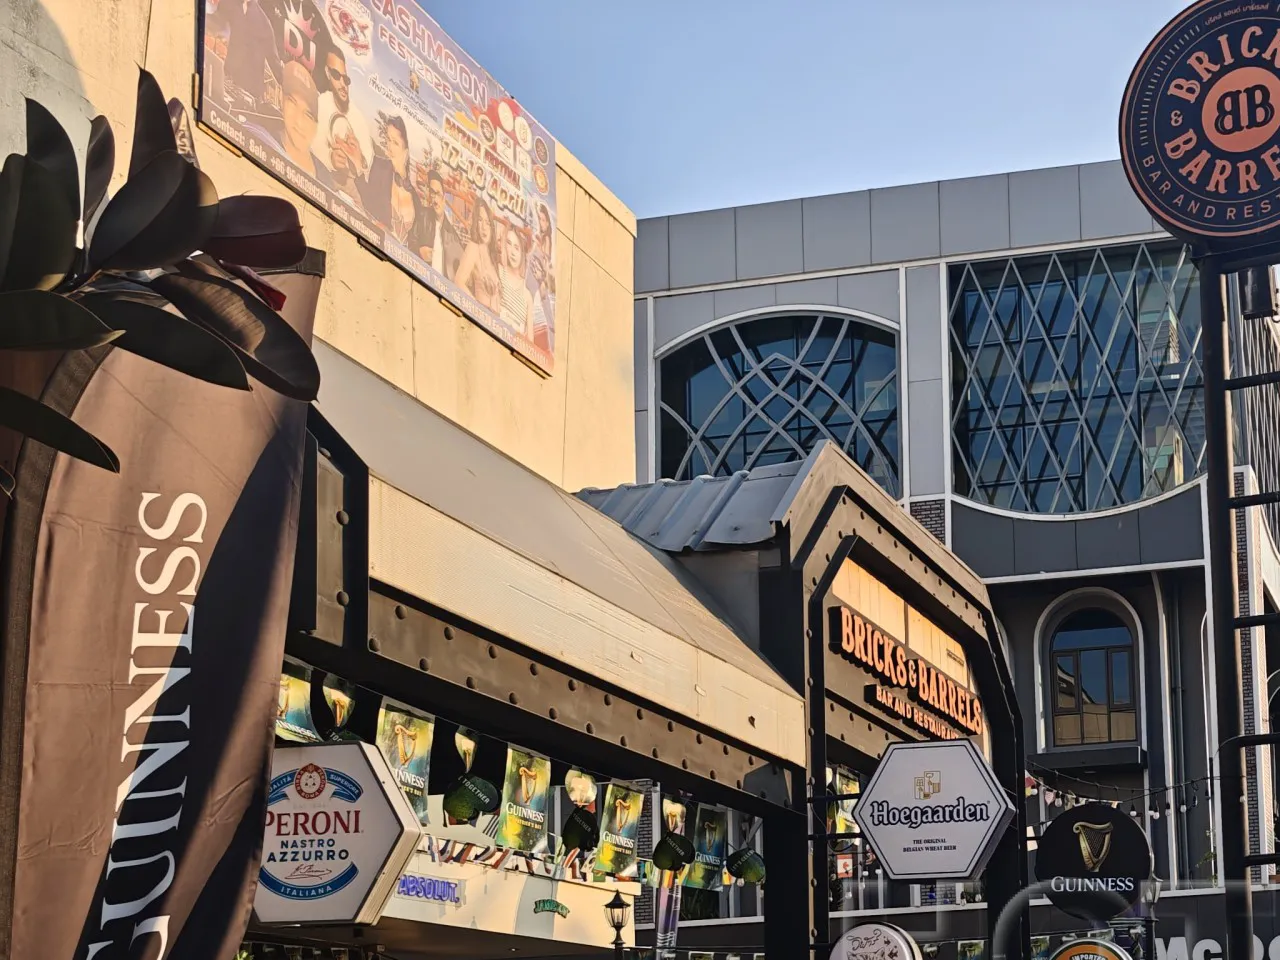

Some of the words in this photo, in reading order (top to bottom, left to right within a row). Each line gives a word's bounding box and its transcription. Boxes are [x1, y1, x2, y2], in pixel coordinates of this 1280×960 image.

[284, 18, 316, 72] DJ
[1142, 155, 1172, 195] BAR
[1173, 193, 1216, 219] AND
[840, 606, 908, 688] BRICKS
[909, 659, 917, 688] &
[917, 658, 982, 736] BARRELS
[876, 686, 894, 709] BAR
[894, 697, 912, 719] AND
[330, 774, 360, 795] SUPERIORE
[461, 777, 491, 805] TOGETHER
[506, 801, 545, 823] GUINNESS
[870, 796, 991, 829] Hoegaarden
[265, 810, 361, 837] PERONI
[281, 838, 336, 849] NASTRO
[602, 830, 635, 849] GUINNESS
[266, 849, 349, 863] AZZURRO
[694, 851, 721, 865] GUINNESS
[281, 885, 333, 896] ITALIANA
[1050, 875, 1135, 893] GUINNESS
